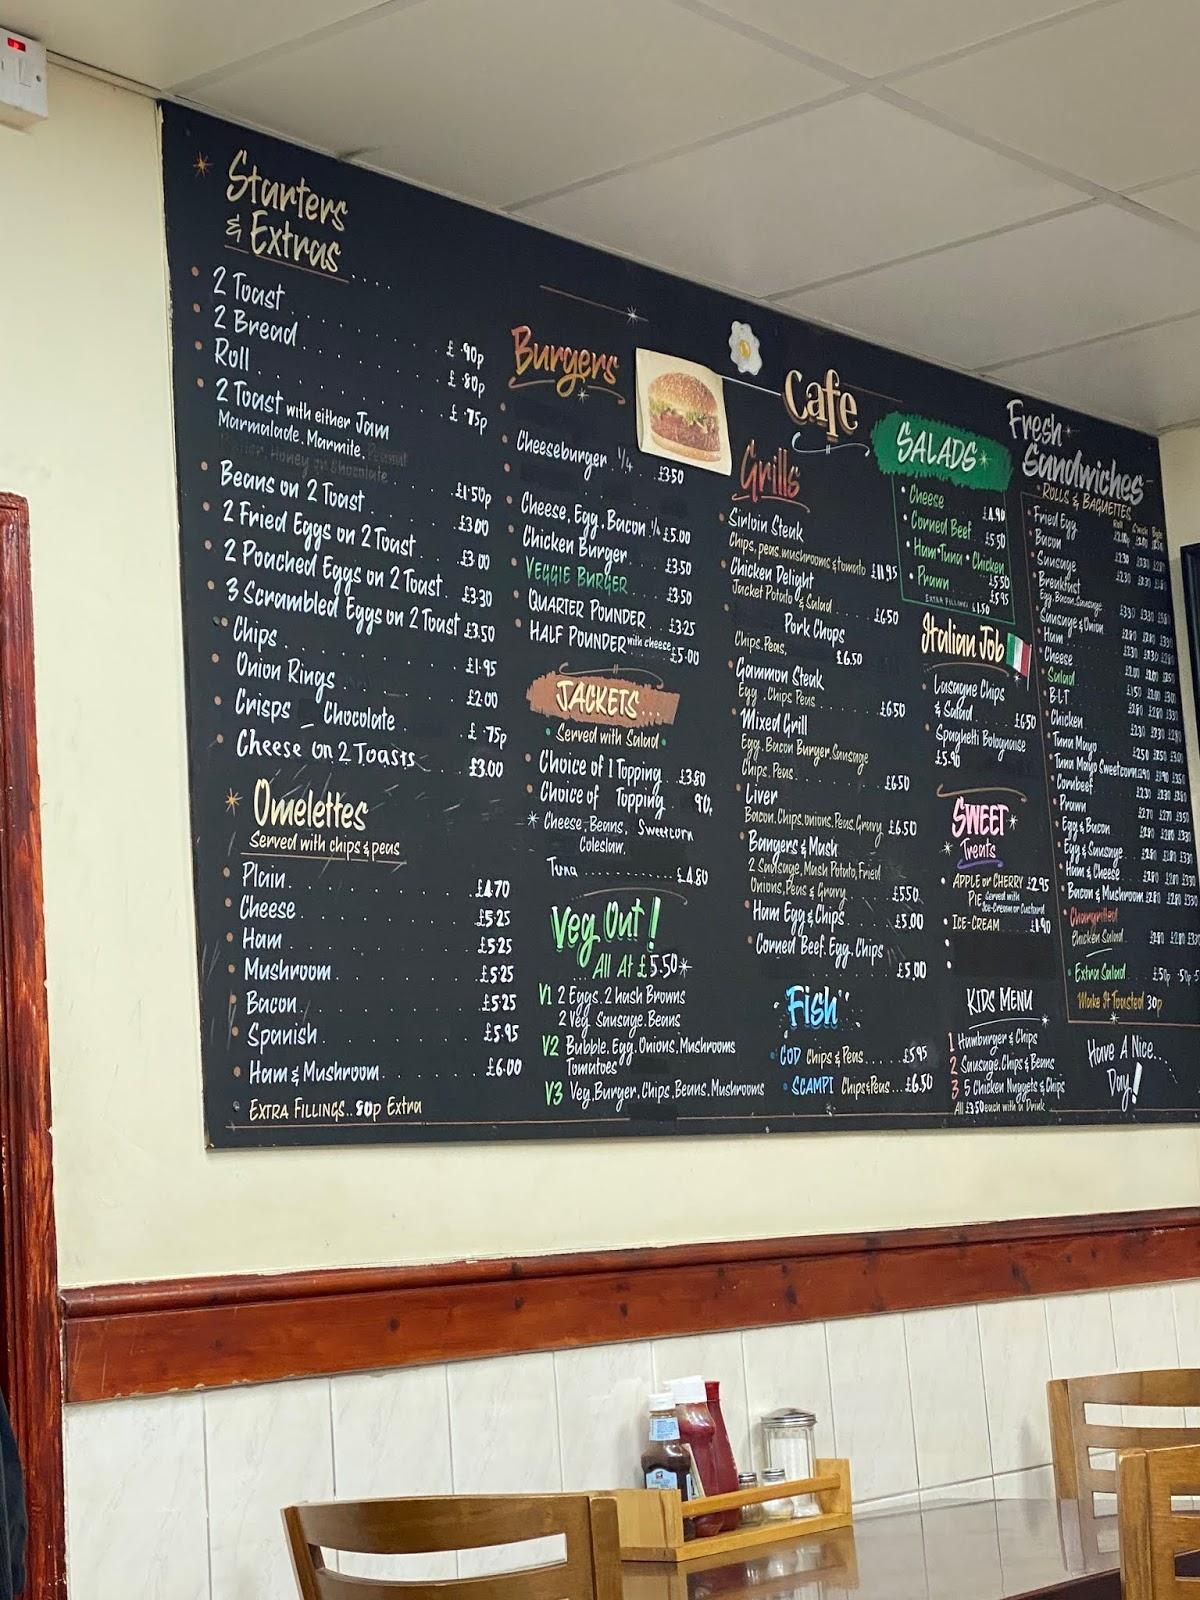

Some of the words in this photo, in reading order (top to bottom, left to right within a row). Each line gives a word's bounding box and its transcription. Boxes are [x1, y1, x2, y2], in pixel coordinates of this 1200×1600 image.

[227, 150, 348, 231] Starters
[250, 210, 341, 272] Extras
[213, 266, 226, 295] 2
[233, 272, 285, 310] Toast
[214, 305, 226, 329] 2
[234, 309, 298, 346] Bread
[215, 338, 249, 372] Roll
[511, 325, 619, 397] Burgers
[215, 378, 228, 402] 2
[233, 380, 283, 416] Toast
[286, 402, 312, 421] with
[315, 407, 351, 427] either
[356, 411, 390, 440] Jam
[783, 368, 858, 442] Cafe
[1006, 398, 1062, 447] Fresh
[517, 430, 607, 481] Cheeseburger
[897, 421, 978, 472] SALADS
[220, 459, 274, 494] Beans
[322, 482, 365, 512] Toast
[740, 440, 800, 502] Grills
[1022, 442, 1144, 506] Sandwiches
[909, 484, 945, 509] Cheese
[1082, 493, 1132, 521] BAGUETTES
[223, 500, 233, 522] 2
[240, 501, 287, 532] Fried
[294, 512, 331, 551] Eggs
[374, 527, 416, 558] Toast
[728, 507, 767, 534] Sirloin
[771, 514, 803, 542] Steak
[911, 510, 948, 535] Corned
[951, 518, 972, 540] Beef
[1034, 505, 1059, 526] Fried
[1060, 512, 1078, 540] Egg
[523, 525, 574, 554] Chicken
[579, 537, 627, 574] Burger
[1035, 528, 1062, 549] Bacon
[224, 539, 236, 561] 2
[243, 540, 317, 577] Poached
[322, 555, 361, 596] Eggs
[403, 569, 443, 598] Toast
[525, 555, 570, 587] VEGGIE
[577, 566, 628, 597] BURGER
[730, 556, 773, 582] Chicken
[776, 565, 814, 601] Delight
[917, 565, 950, 590] Prawn
[1036, 551, 1077, 578] Sausage
[732, 578, 763, 598] Jacket
[765, 584, 792, 605] Potato
[806, 594, 832, 613] Salad
[1038, 571, 1081, 595] Breakfast
[226, 577, 239, 601] 3
[244, 580, 338, 619] Scrambled
[346, 597, 382, 636] Eggs
[422, 608, 461, 637] Toast
[528, 588, 584, 618] QUARTER
[590, 599, 646, 628] POUNDER
[233, 615, 277, 652] Chips
[530, 620, 566, 643] HALF
[569, 627, 627, 654] POUNDER
[784, 612, 810, 638] Pork
[813, 618, 845, 648] Chops
[921, 612, 976, 658] Italian
[979, 625, 1004, 662] Job
[1043, 627, 1064, 645] Ham
[1044, 646, 1073, 666] Cheese
[237, 651, 281, 681] Onion
[288, 658, 335, 703] Rings
[736, 657, 788, 683] Gammon
[792, 665, 824, 690] Steak
[1048, 666, 1075, 686] Salad
[934, 674, 977, 708] Lasagne
[980, 679, 1005, 706] Chips
[235, 687, 290, 723] Crisps
[324, 700, 395, 731] Chocolate
[740, 708, 780, 732] Mixed
[783, 714, 808, 738] Grill
[943, 700, 973, 722] Salad
[1051, 709, 1083, 729] Chicken
[237, 729, 301, 758] Cheese
[353, 742, 415, 767] Toasts
[556, 723, 596, 743] Served
[600, 728, 621, 745] with
[626, 730, 660, 749] Salad
[936, 724, 979, 753] Spaghetti
[1075, 735, 1097, 761] Mayo
[539, 749, 586, 776] Choice
[616, 758, 662, 794] Topping
[254, 778, 369, 831] Omelettes
[540, 780, 582, 803] Choice
[616, 787, 665, 820] Topping
[746, 782, 778, 806] Liver
[1059, 794, 1087, 813] Prawn
[638, 819, 694, 841] Sweetcorn
[952, 796, 1009, 838] SWEET
[249, 831, 296, 851] Served
[300, 834, 325, 853] with
[329, 836, 360, 861] chips
[372, 842, 400, 861] peas
[748, 829, 799, 864] Bangers
[809, 836, 838, 857] Mash
[960, 838, 996, 861] Treats
[242, 861, 285, 889] Plain
[953, 873, 980, 888] APPLE
[993, 874, 1023, 889] CHERRY
[240, 895, 295, 920] Cheese
[968, 890, 982, 907] PIE
[1102, 884, 1144, 903] Mushroom
[753, 899, 779, 921] Ham
[784, 901, 805, 936] Egg
[952, 914, 1000, 931] ICE-CREAM
[242, 927, 281, 949] Ham
[551, 905, 601, 968] Veg
[756, 933, 796, 955] Corned
[244, 957, 331, 981] Mushroom
[592, 953, 611, 979] All
[246, 990, 296, 1015] Bacon
[538, 983, 552, 1005] V1
[615, 985, 643, 1004] hash
[646, 985, 685, 1005] Browns
[785, 985, 838, 1029] Fish
[966, 988, 995, 1016] KIDS
[1000, 987, 1033, 1012] MENU
[247, 1022, 317, 1055] Spanish
[558, 1011, 566, 1027] 2
[570, 1011, 590, 1038] Veg
[542, 1035, 559, 1057] V2
[780, 1045, 801, 1066] COD
[958, 1031, 1007, 1056] Hamburger
[1087, 1039, 1115, 1068] Have
[1119, 1034, 1128, 1060] A
[250, 1060, 288, 1085] Ham
[303, 1060, 379, 1083] Mushroom
[566, 1058, 617, 1076] Tomatoes
[545, 1081, 563, 1105] V3
[791, 1076, 834, 1095] SCAMPI
[1006, 1078, 1037, 1102] Nuggets
[1045, 1078, 1065, 1099] Chips
[249, 1099, 288, 1121] EXTRA
[387, 1096, 422, 1115] Extra
